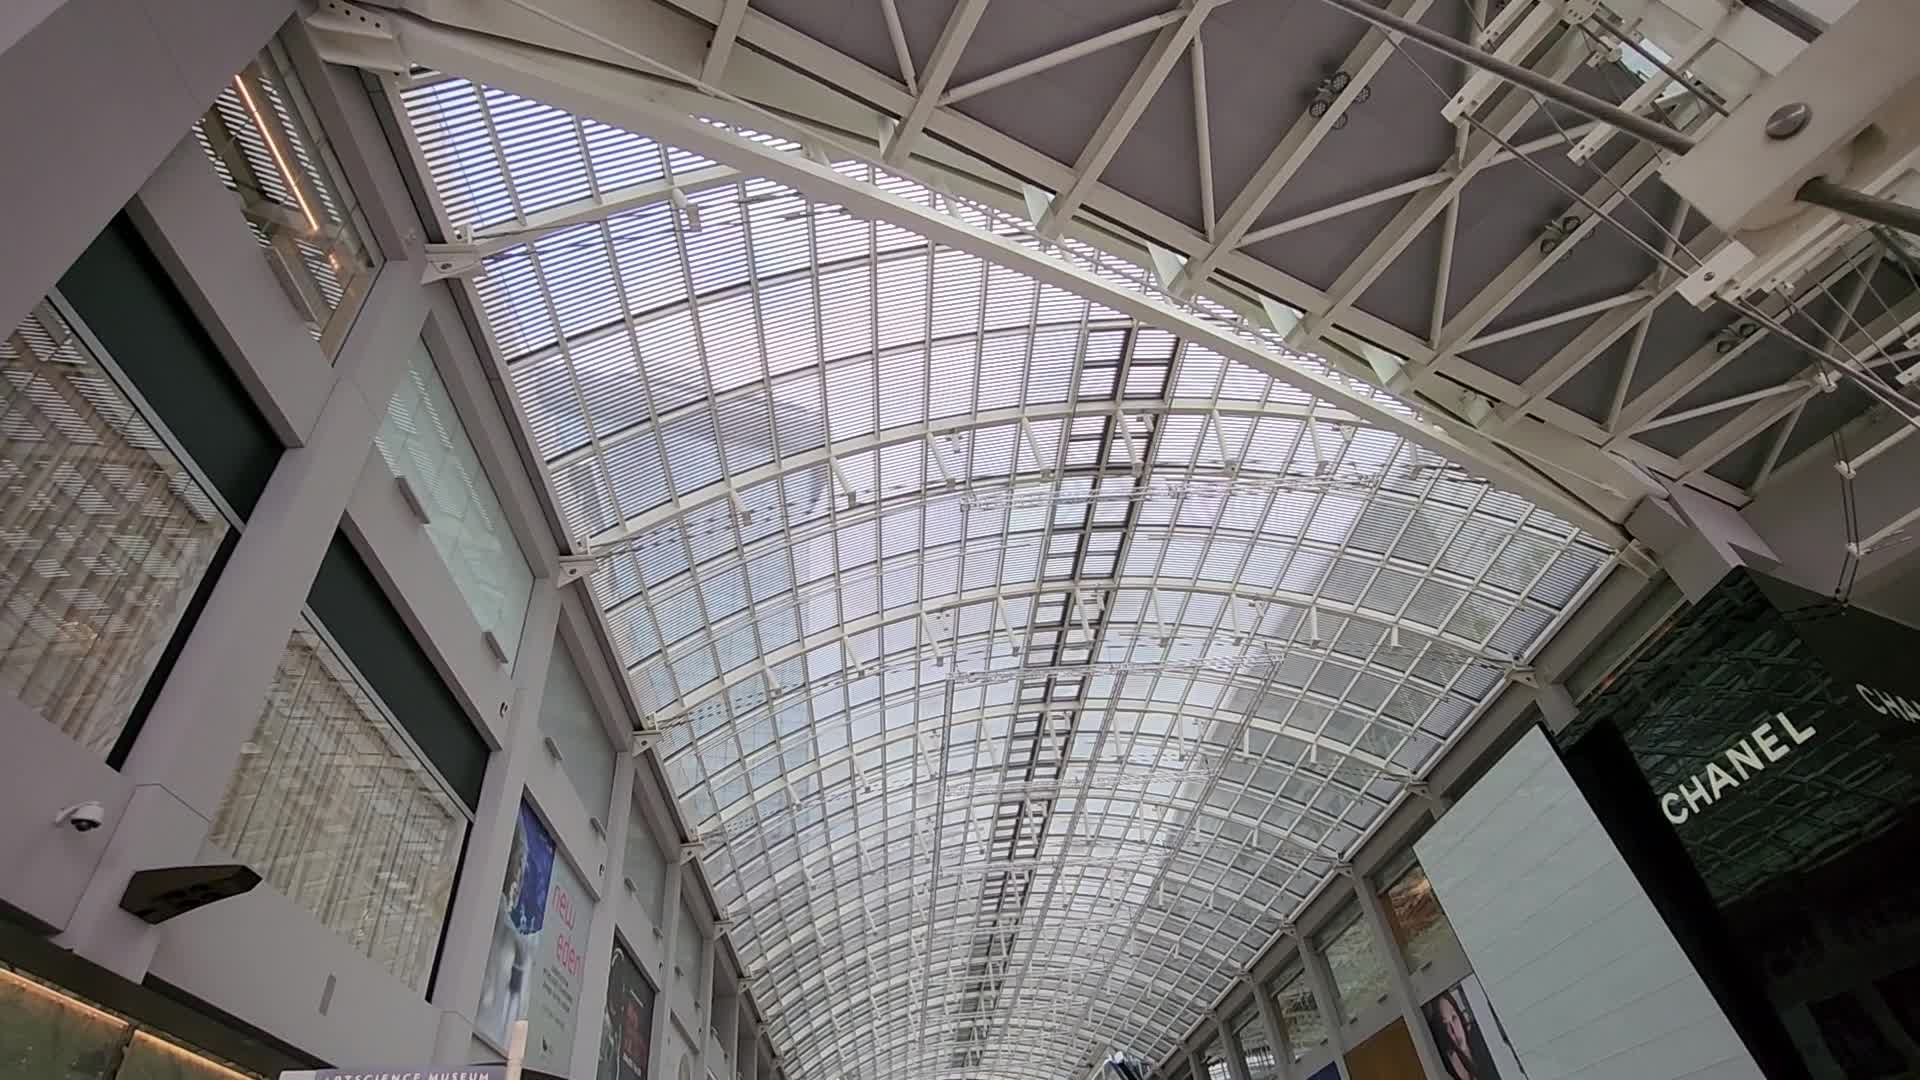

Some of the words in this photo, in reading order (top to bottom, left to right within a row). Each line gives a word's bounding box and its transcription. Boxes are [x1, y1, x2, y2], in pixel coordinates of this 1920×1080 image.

[1660, 711, 1816, 825] CHANEL
[552, 884, 577, 931] new
[556, 934, 584, 981] eden
[429, 1072, 489, 1080] MUSEUM
